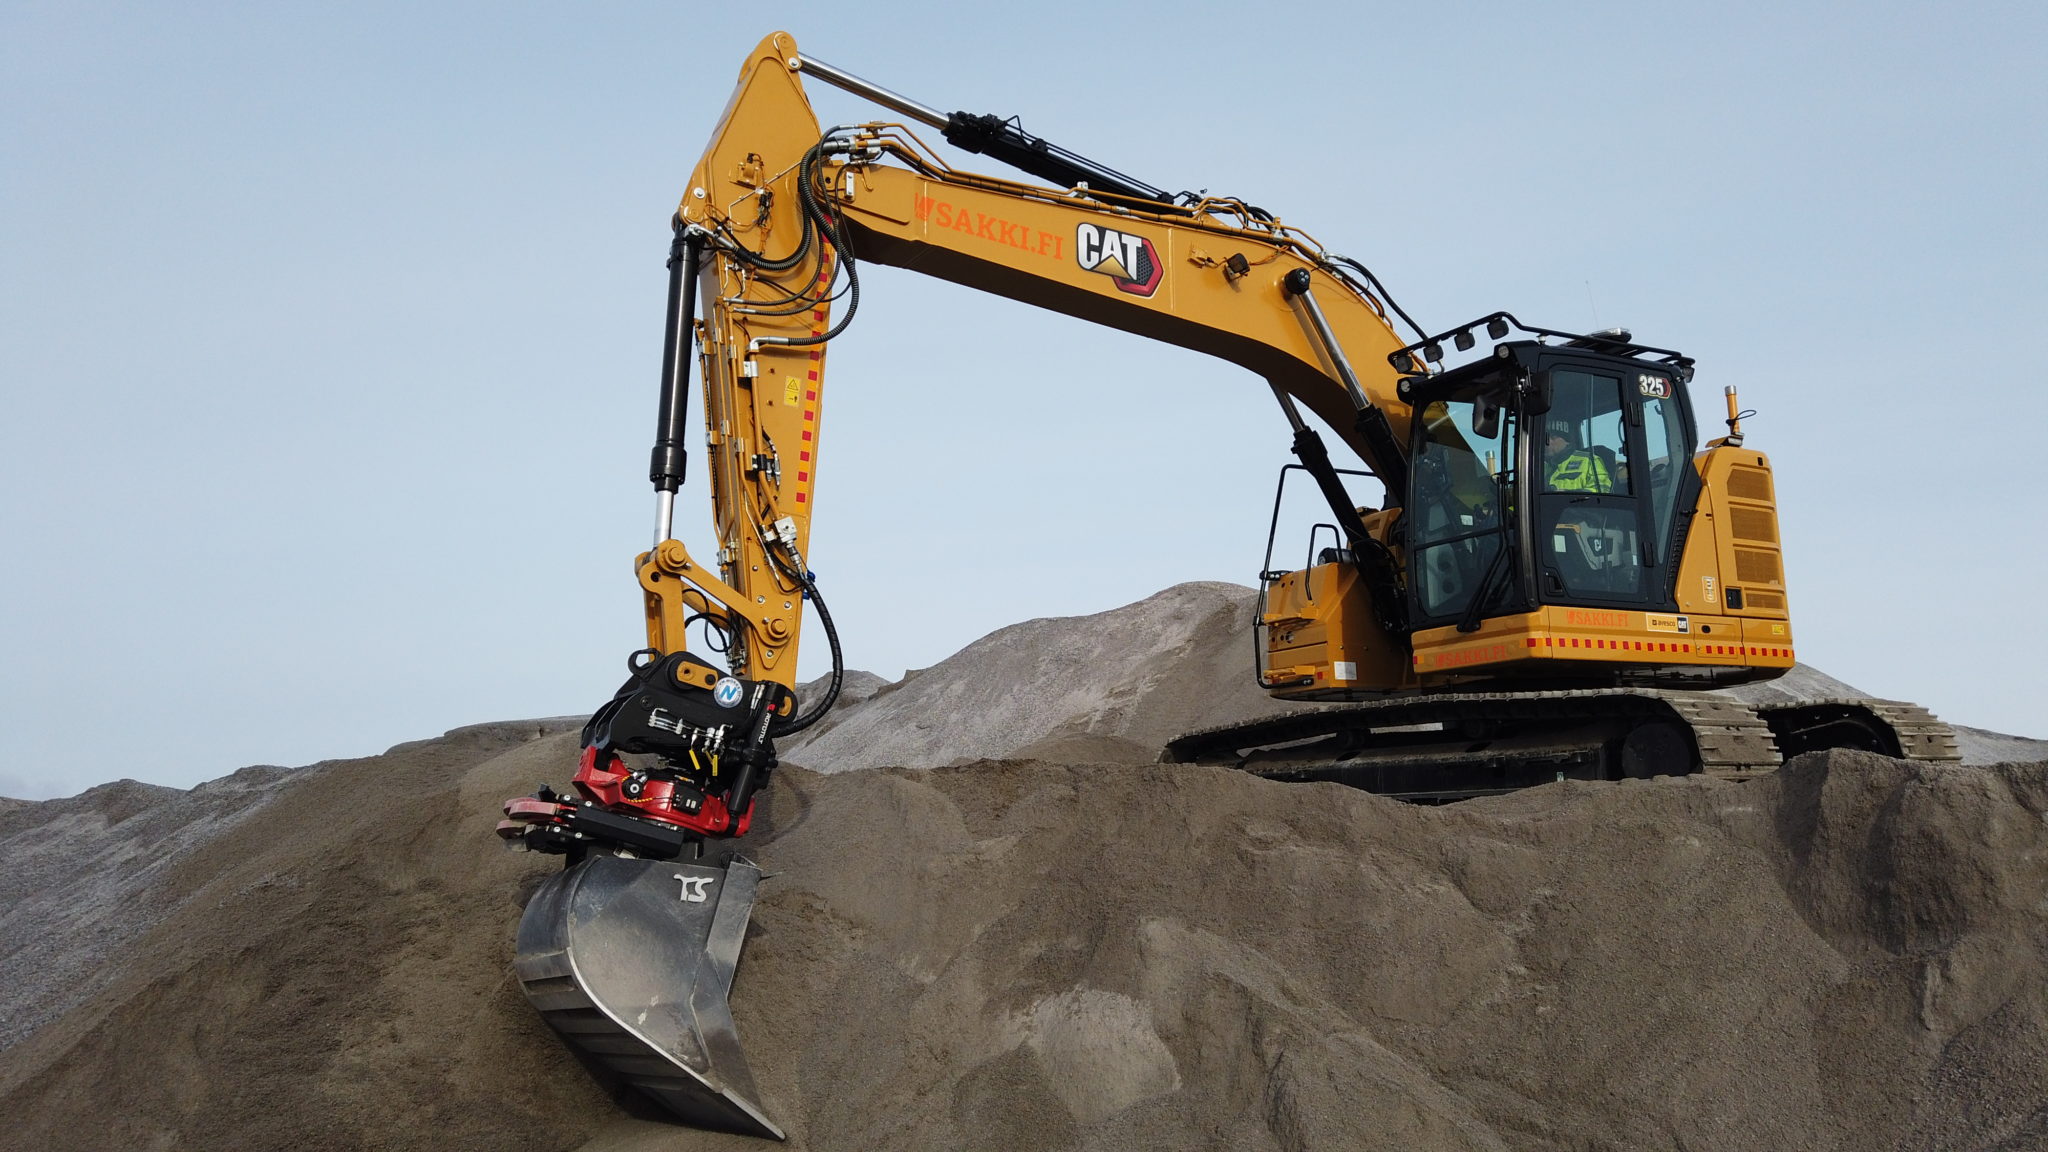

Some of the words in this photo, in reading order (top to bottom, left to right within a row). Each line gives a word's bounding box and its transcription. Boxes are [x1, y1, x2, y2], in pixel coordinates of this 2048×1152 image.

[935, 200, 1064, 261] SAKKI.FI
[1077, 222, 1143, 282] CAT
[1639, 374, 1664, 397] 325
[673, 873, 714, 903] TS
